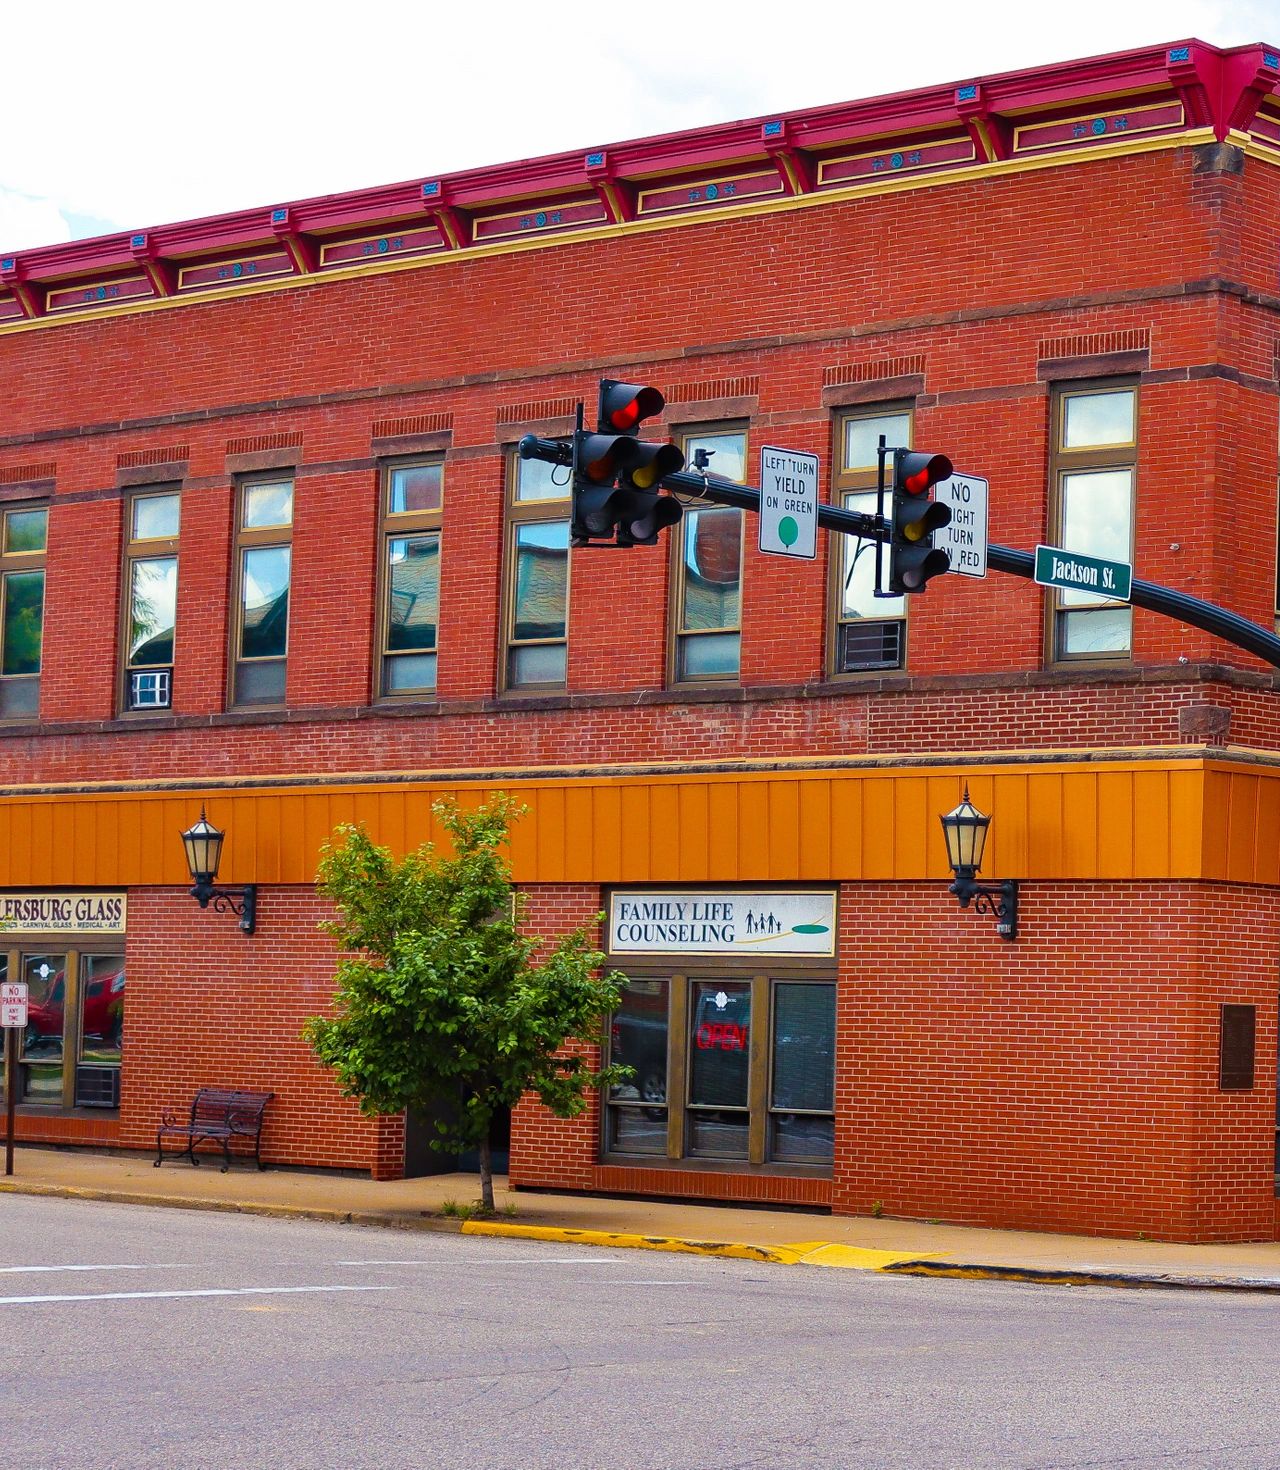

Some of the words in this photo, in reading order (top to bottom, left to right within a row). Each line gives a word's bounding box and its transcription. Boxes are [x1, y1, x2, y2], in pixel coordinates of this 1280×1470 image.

[765, 456, 786, 470] LEFT
[792, 461, 815, 476] TURN
[774, 475, 805, 494] YIELD
[951, 482, 971, 503] NO
[766, 496, 779, 508] ON
[784, 499, 812, 514] GREEN
[952, 508, 975, 526] IGHT
[947, 527, 973, 546] TURN
[960, 550, 980, 567] RED
[1050, 556, 1098, 586] Jackson
[1102, 566, 1116, 590] St.
[75, 898, 122, 921] GLASS
[620, 903, 687, 921] FAMILY
[692, 903, 734, 921] LIFE
[617, 924, 735, 943] COUNSELING
[9, 987, 19, 996] NO
[696, 1023, 747, 1050] OPEN
